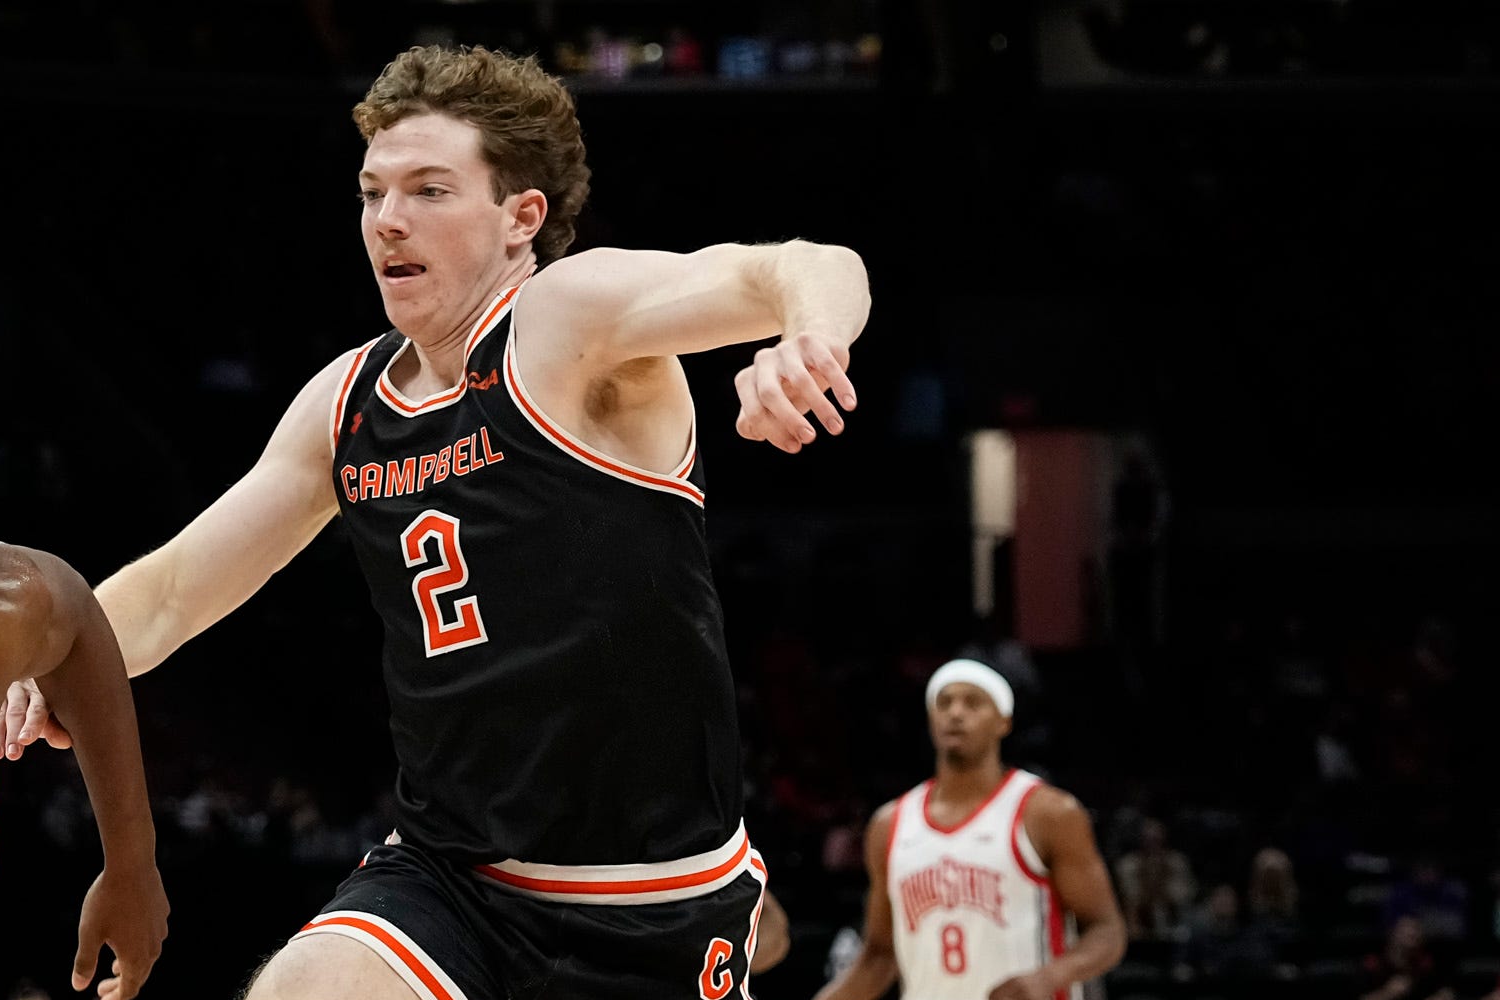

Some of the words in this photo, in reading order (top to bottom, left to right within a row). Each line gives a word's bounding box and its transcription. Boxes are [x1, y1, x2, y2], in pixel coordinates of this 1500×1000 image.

[340, 426, 504, 503] CAMPBELL
[400, 509, 489, 658] 2
[940, 923, 968, 976] 8
